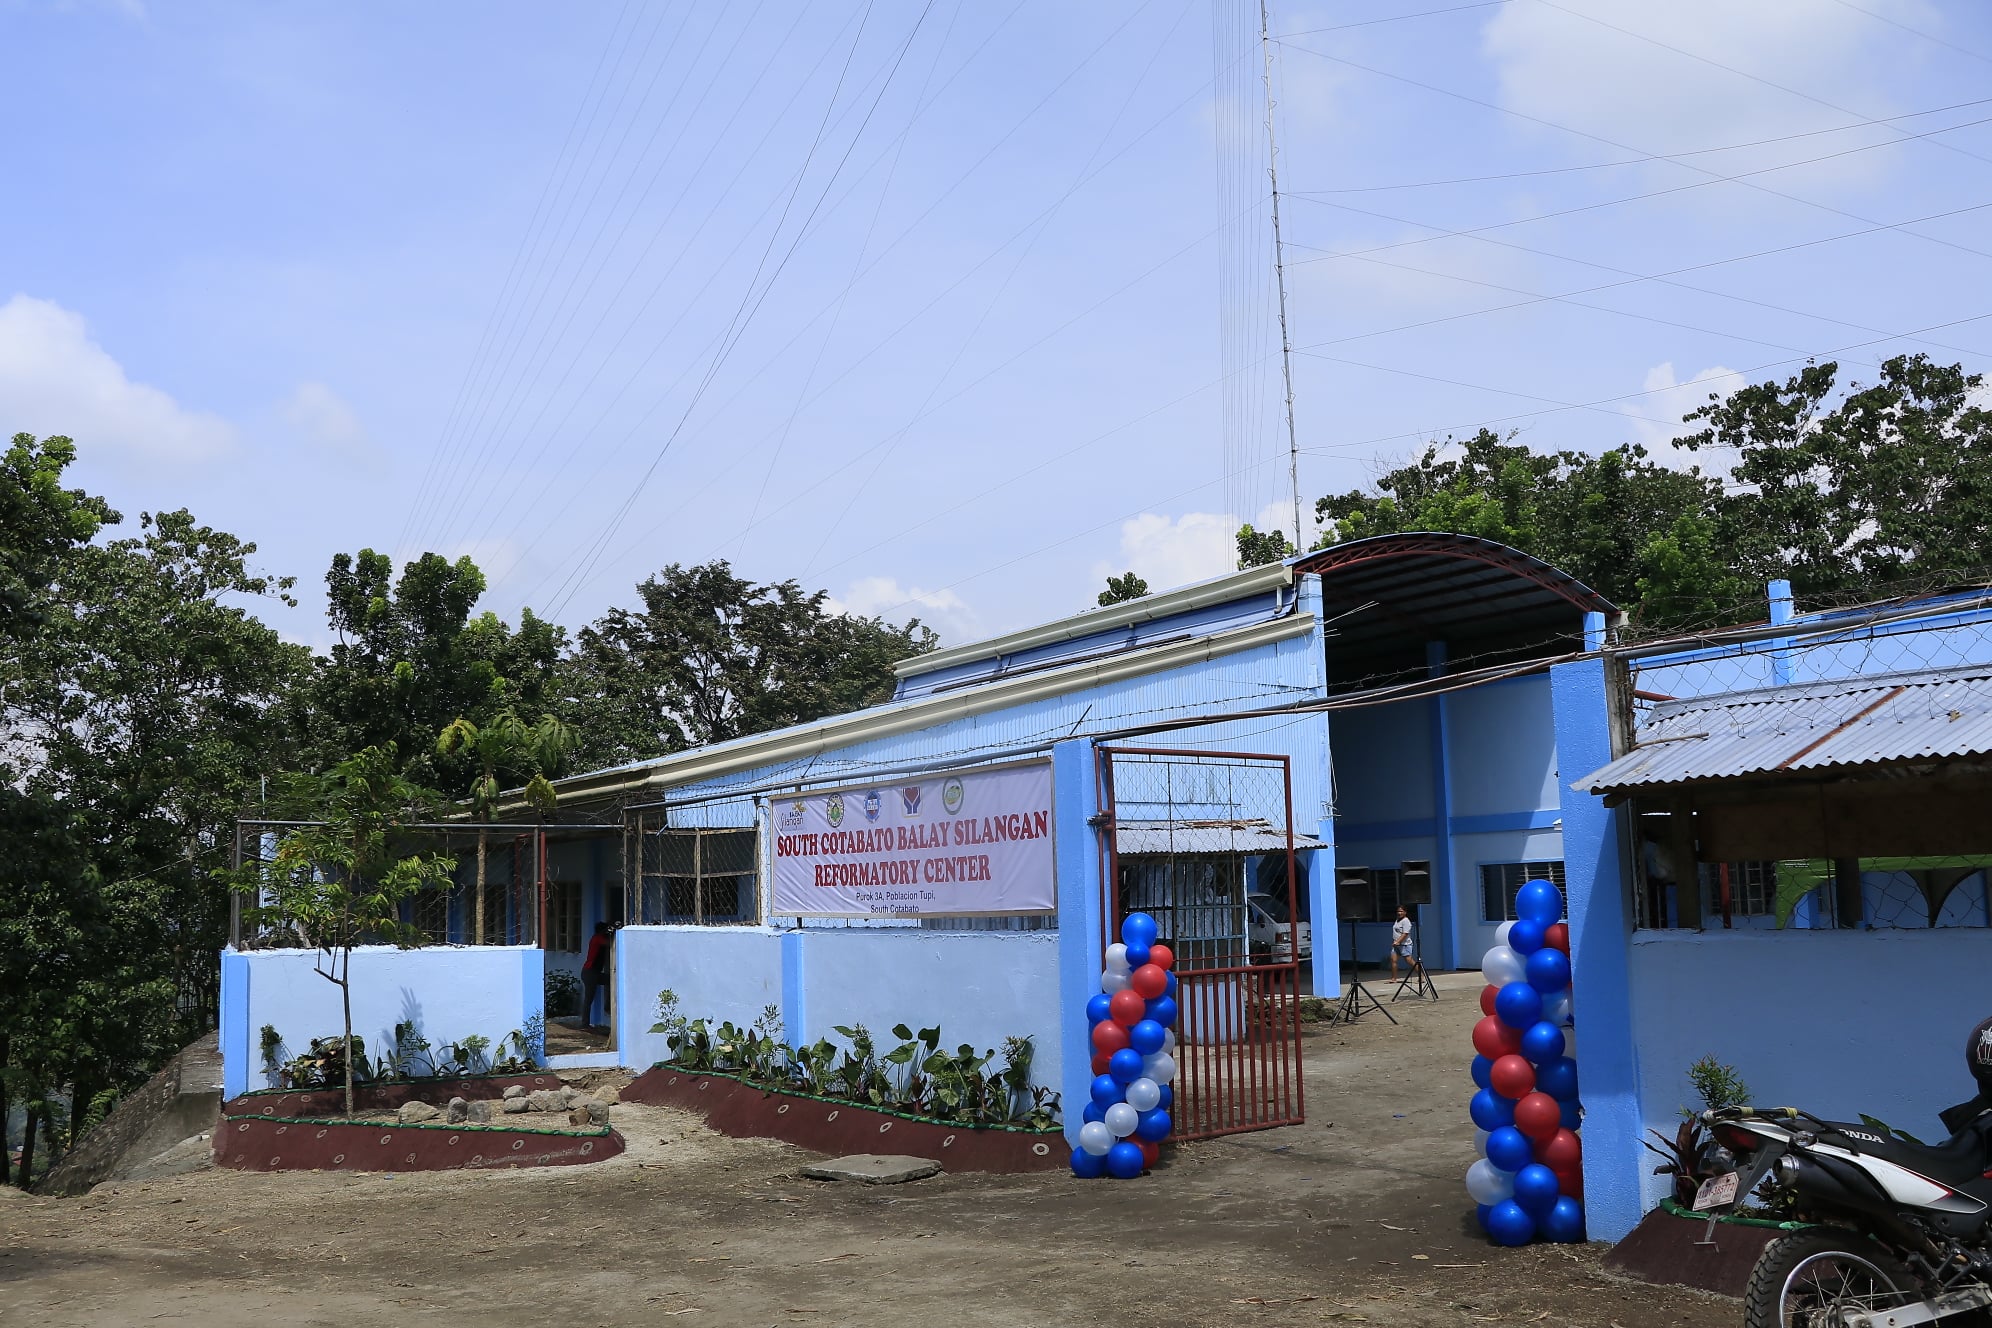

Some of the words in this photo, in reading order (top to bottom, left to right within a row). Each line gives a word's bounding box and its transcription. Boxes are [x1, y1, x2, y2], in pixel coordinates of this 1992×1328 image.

[777, 833, 819, 858] SOUTH
[821, 827, 894, 855] COTABATO
[897, 821, 951, 851] BALAY
[954, 810, 1048, 846] SILANGAN
[814, 859, 920, 887] REFORMATORY
[923, 854, 991, 883] CENTER
[856, 892, 873, 901] Purok
[886, 891, 918, 901] Poblacion
[919, 890, 936, 902] Tupi,
[870, 904, 889, 914] South
[890, 904, 920, 914] Cotabato
